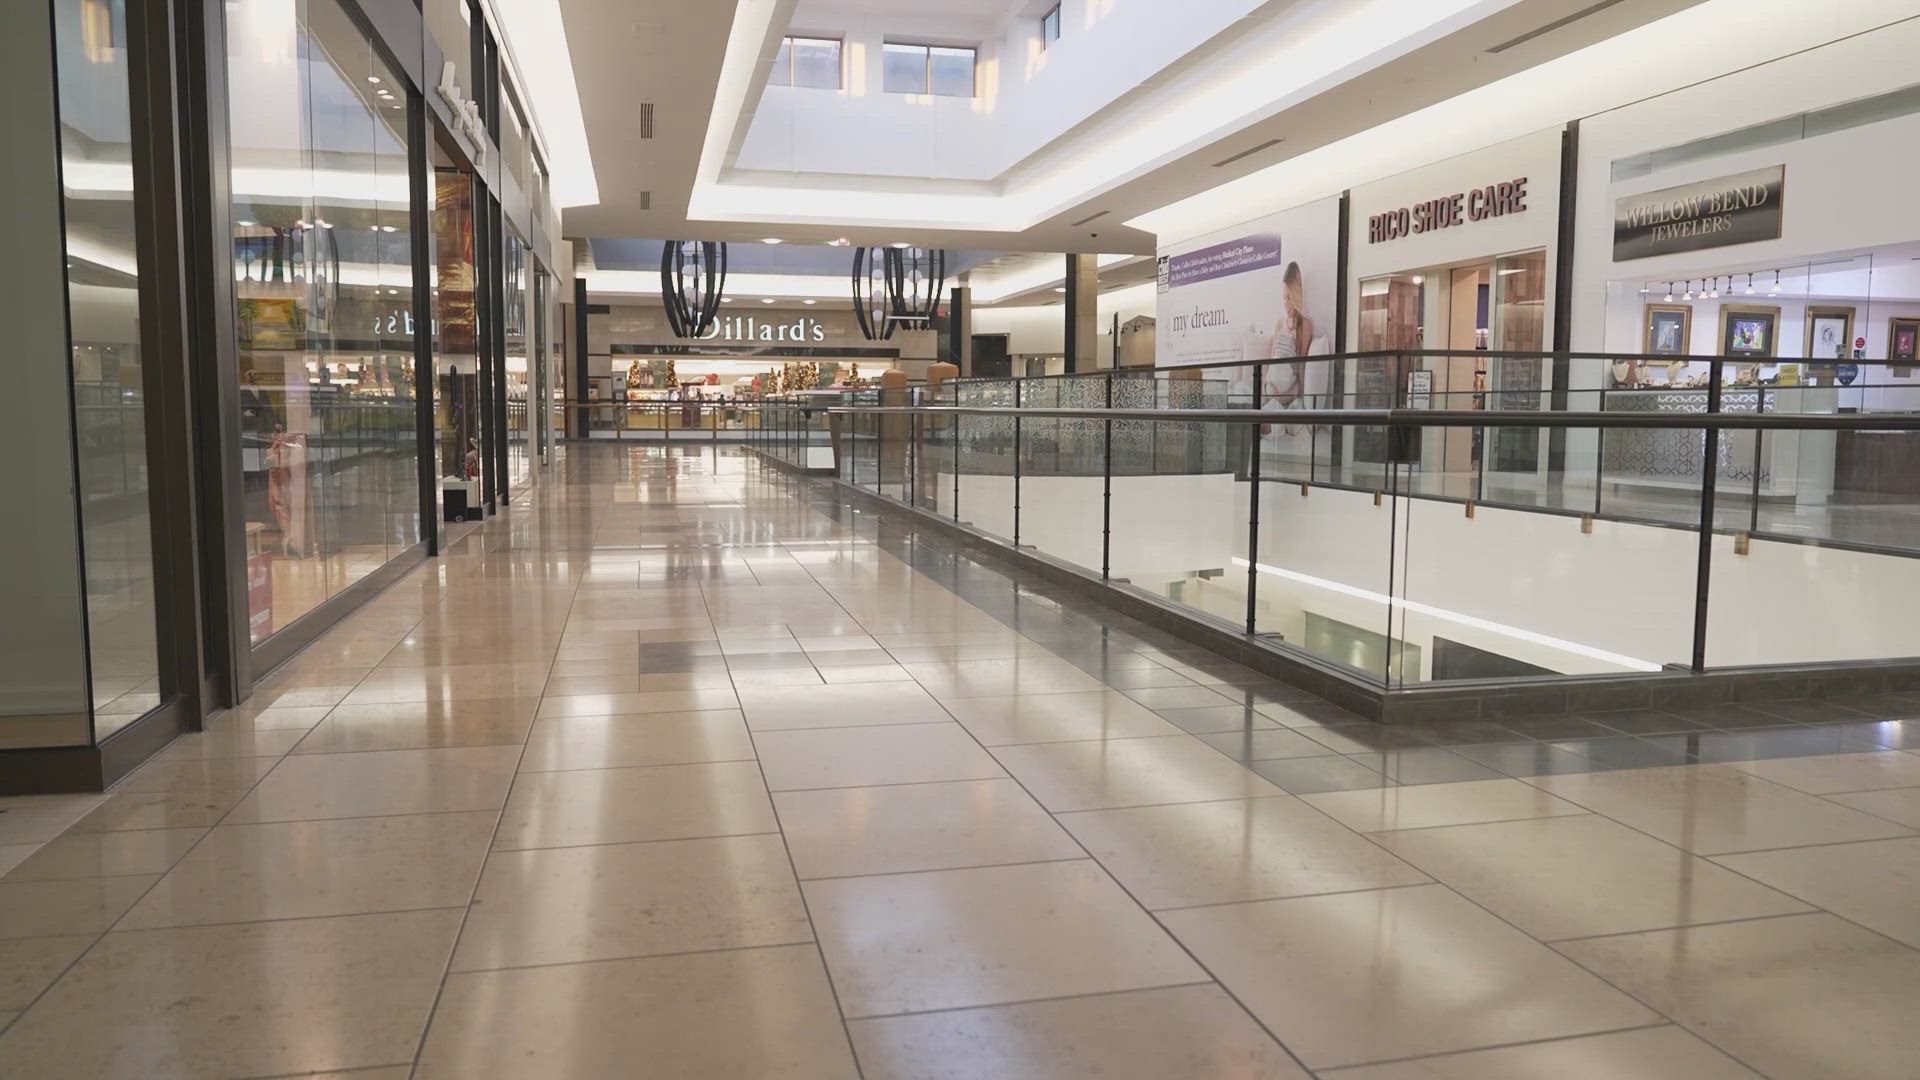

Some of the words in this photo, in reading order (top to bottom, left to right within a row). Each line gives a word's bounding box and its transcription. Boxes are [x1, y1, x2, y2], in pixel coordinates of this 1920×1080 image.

[1368, 207, 1410, 244] RICO
[1412, 192, 1464, 234] SHOE
[1468, 177, 1527, 222] CARE
[1625, 193, 1706, 229] WILLOW
[1708, 183, 1769, 217] BEND
[1649, 214, 1733, 246] JEWELERS
[693, 311, 825, 342] Dillard's
[1173, 313, 1187, 337] my
[1191, 305, 1229, 329] dream.
